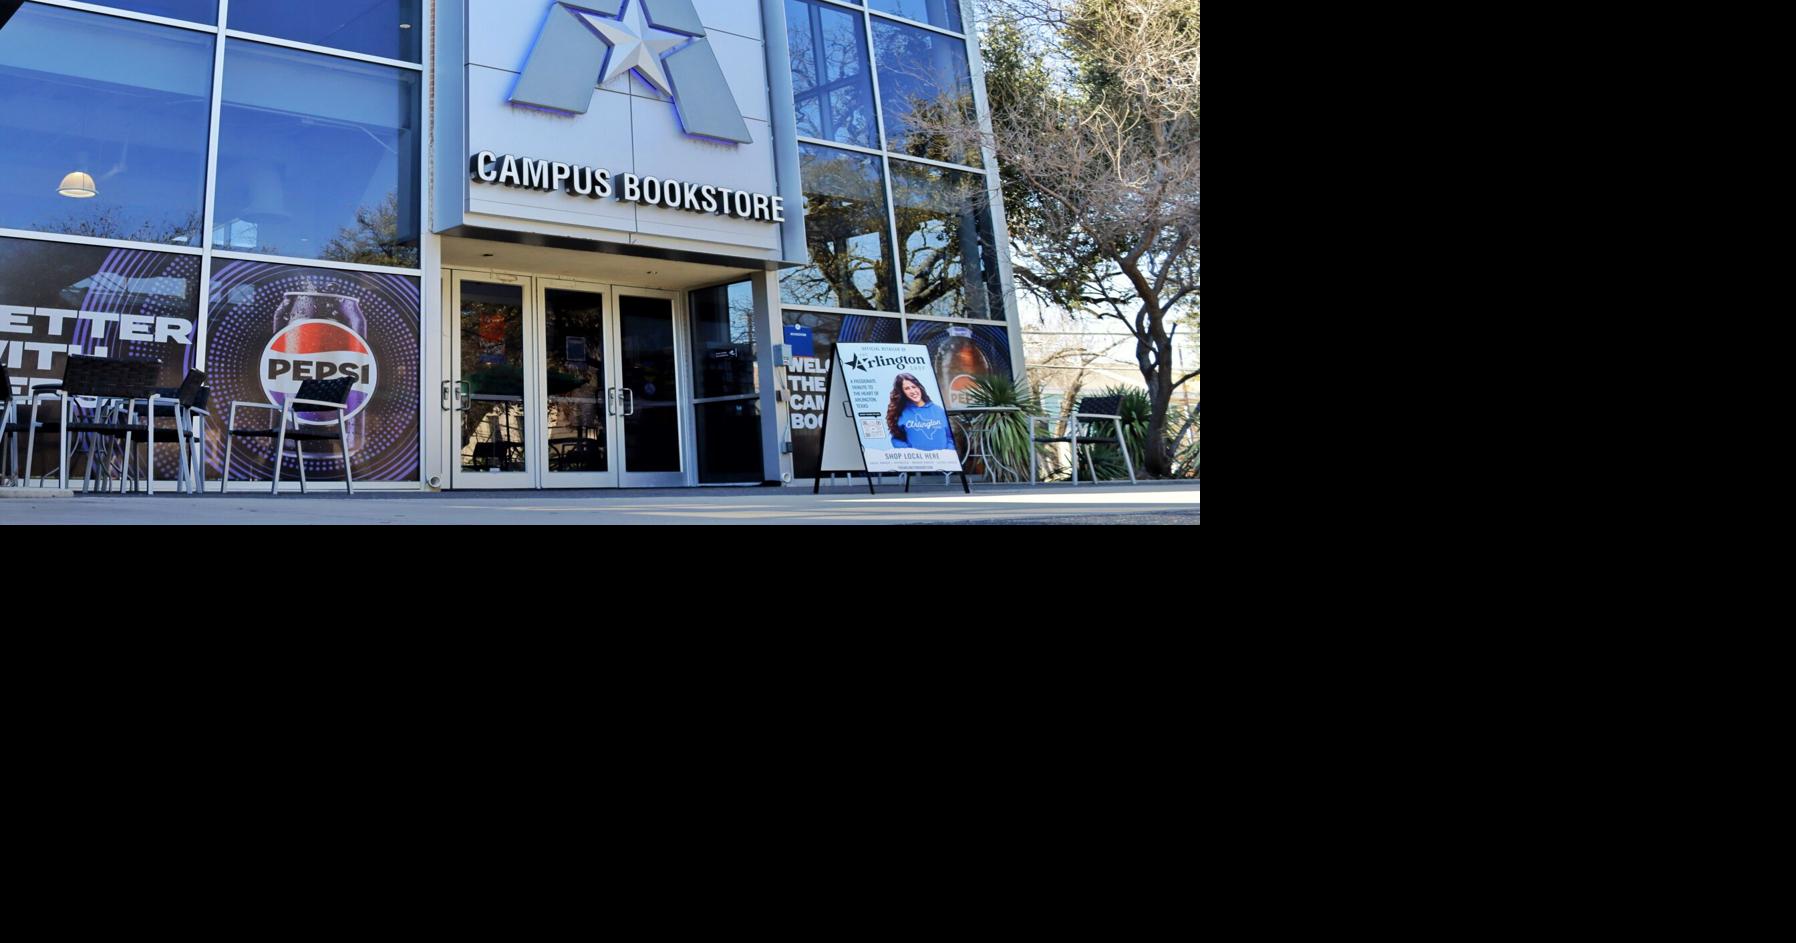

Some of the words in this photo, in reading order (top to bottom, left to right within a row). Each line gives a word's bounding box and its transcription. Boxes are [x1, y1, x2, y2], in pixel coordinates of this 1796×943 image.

[475, 150, 611, 198] CAMPUS
[623, 171, 785, 222] BOOKSTORE
[268, 358, 370, 384] PEPSI
[788, 375, 827, 392] THE
